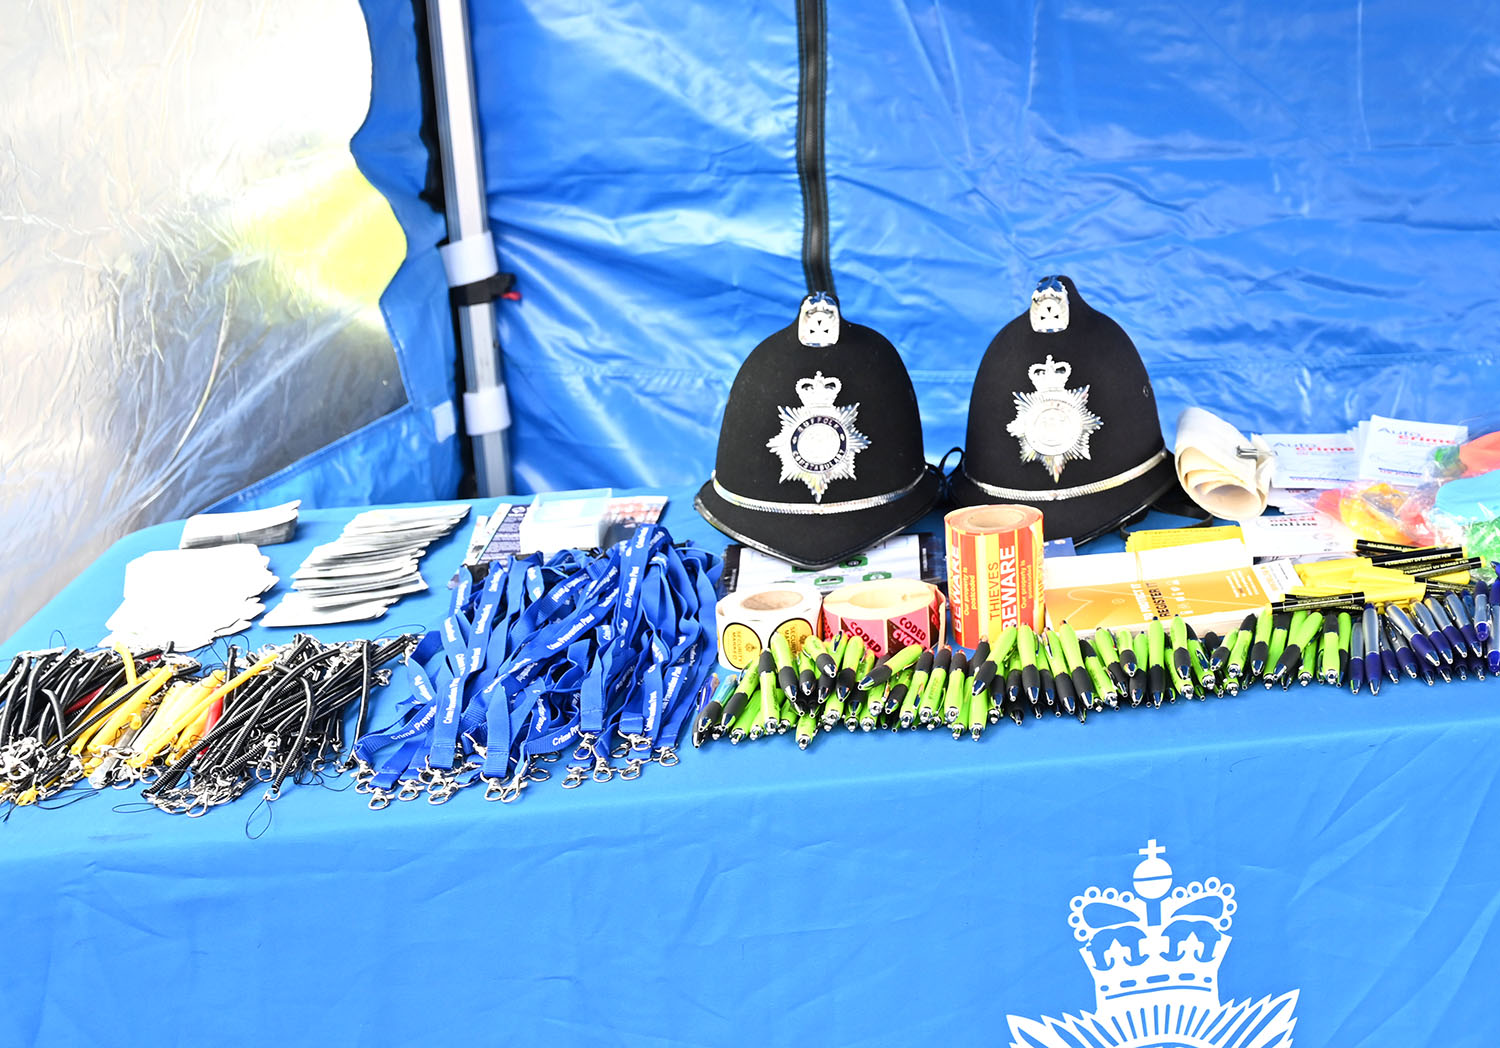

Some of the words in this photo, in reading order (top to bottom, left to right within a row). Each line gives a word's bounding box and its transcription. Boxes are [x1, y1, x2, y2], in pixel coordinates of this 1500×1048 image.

[951, 545, 962, 633] BEWARE
[969, 574, 978, 610] postcoded
[988, 561, 1000, 621] THIEVES
[999, 545, 1017, 630] BEWARE
[1148, 588, 1171, 618] REGISTER
[793, 626, 802, 654] SECURIT
[850, 621, 882, 653] CODED
[892, 628, 915, 647] CYCL
[899, 617, 927, 642] CODED
[390, 729, 415, 741] Crime
[552, 732, 572, 746] Crime
